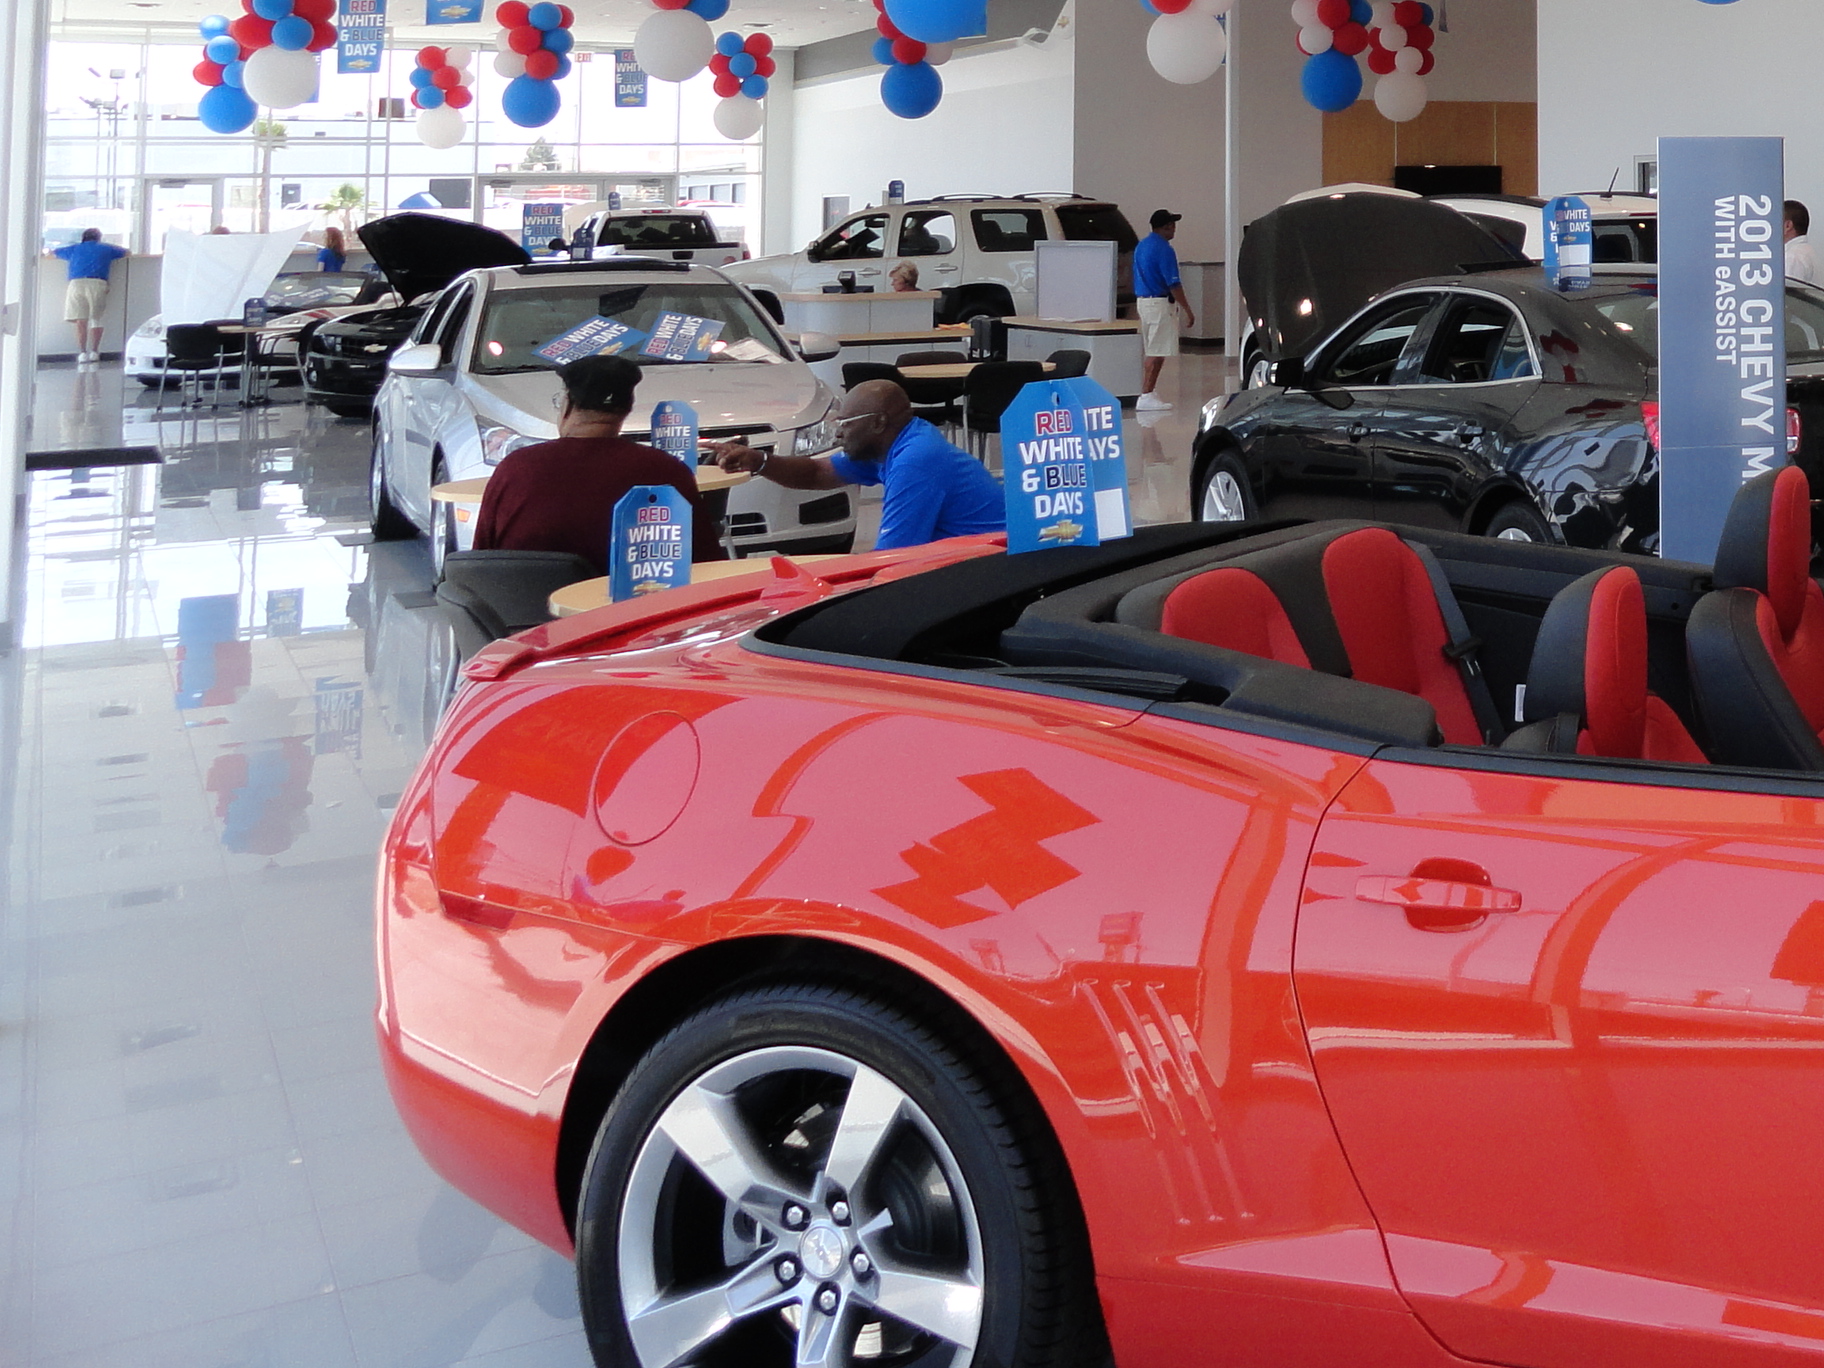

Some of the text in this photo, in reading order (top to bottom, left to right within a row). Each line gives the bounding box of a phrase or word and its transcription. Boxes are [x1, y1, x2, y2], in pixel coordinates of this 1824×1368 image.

[350, 0, 377, 12] RED
[341, 14, 384, 27] WHITE
[340, 29, 383, 42] & BLUE
[345, 43, 377, 56] DAYS
[622, 51, 635, 61] RE
[616, 74, 623, 83] &
[619, 84, 644, 94] DAYS
[531, 206, 554, 215] RED
[524, 216, 561, 225] WHITE
[1570, 221, 1590, 232] DAYS
[524, 226, 561, 235] & BLUE
[1739, 194, 1773, 287] 2013
[1714, 195, 1737, 366] WITH eASSIST
[539, 319, 610, 357] RED WHITE
[566, 339, 600, 361] BLUE
[594, 324, 629, 345] DAYS
[645, 314, 682, 355] RED WHITE
[666, 316, 703, 361] & BLUE DAYS
[1740, 298, 1775, 435] CHEVY
[660, 413, 682, 426] RED
[1035, 409, 1073, 436] RED
[656, 426, 691, 438] WHITE
[1019, 437, 1084, 465] WHITE
[1088, 435, 1120, 461] AYS
[1022, 463, 1087, 492] & BLUE
[1035, 491, 1084, 519] DAYS
[637, 506, 670, 523] RED
[629, 525, 681, 543] WHITE
[628, 543, 682, 562] & BLUE
[632, 561, 674, 580] DAYS
